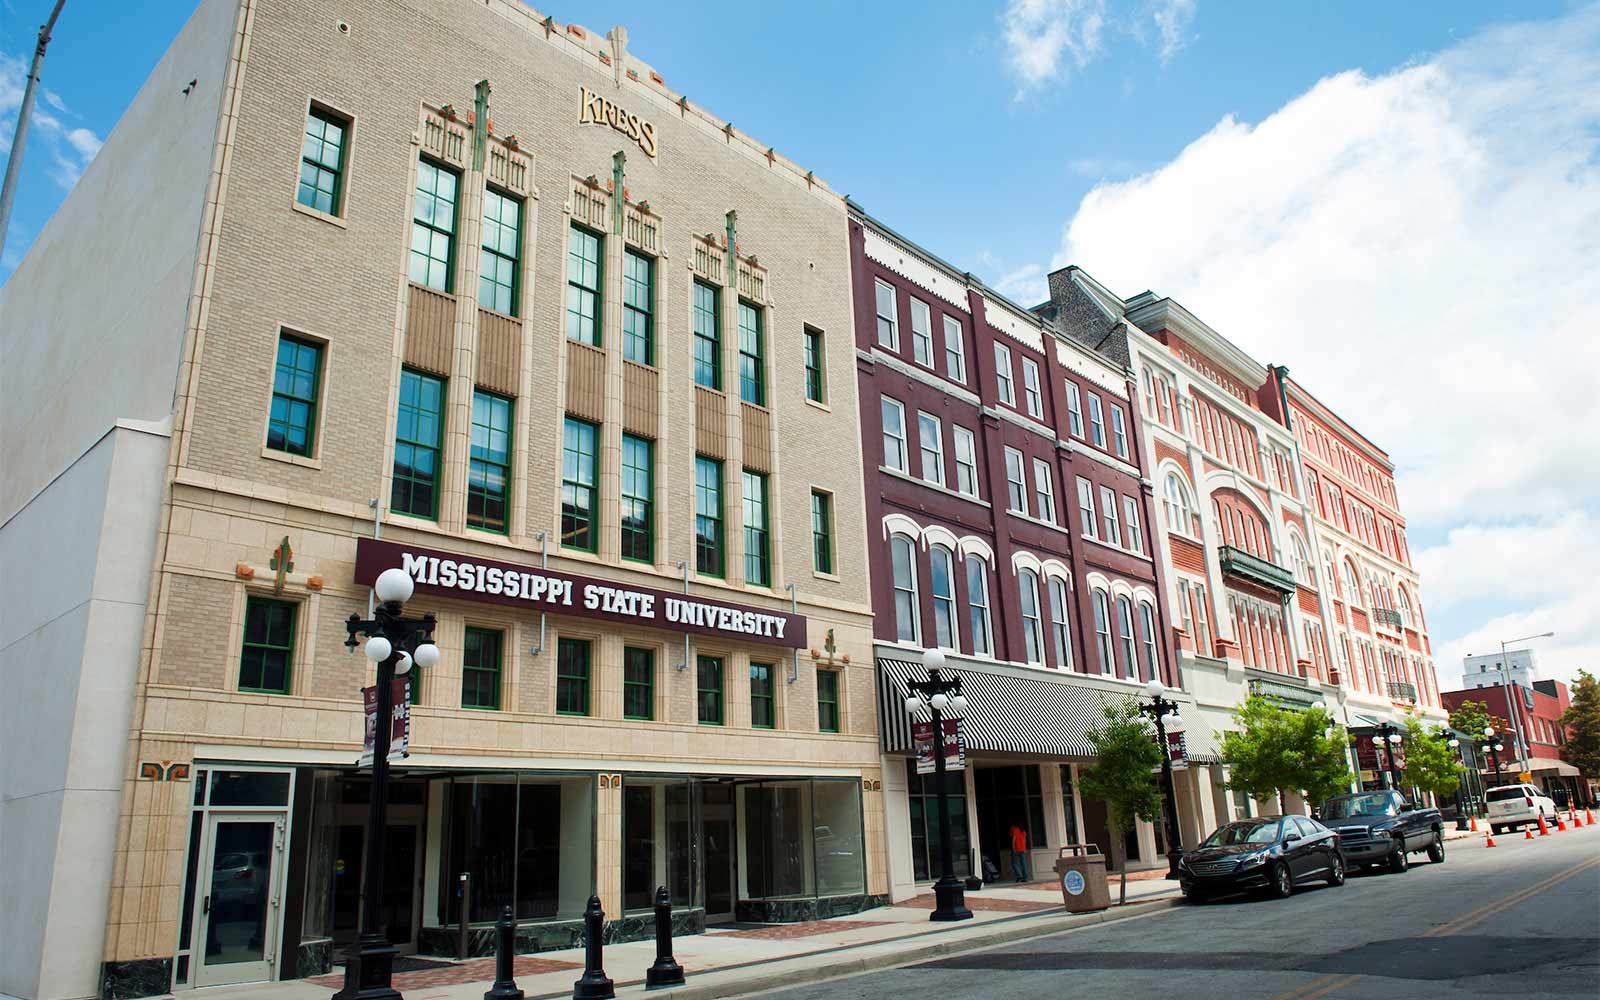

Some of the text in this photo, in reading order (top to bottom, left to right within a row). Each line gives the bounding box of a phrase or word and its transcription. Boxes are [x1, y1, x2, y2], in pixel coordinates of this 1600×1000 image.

[579, 86, 657, 158] KRESS
[402, 553, 787, 639] MISSISSIPPI STATE UNIVERSITY
